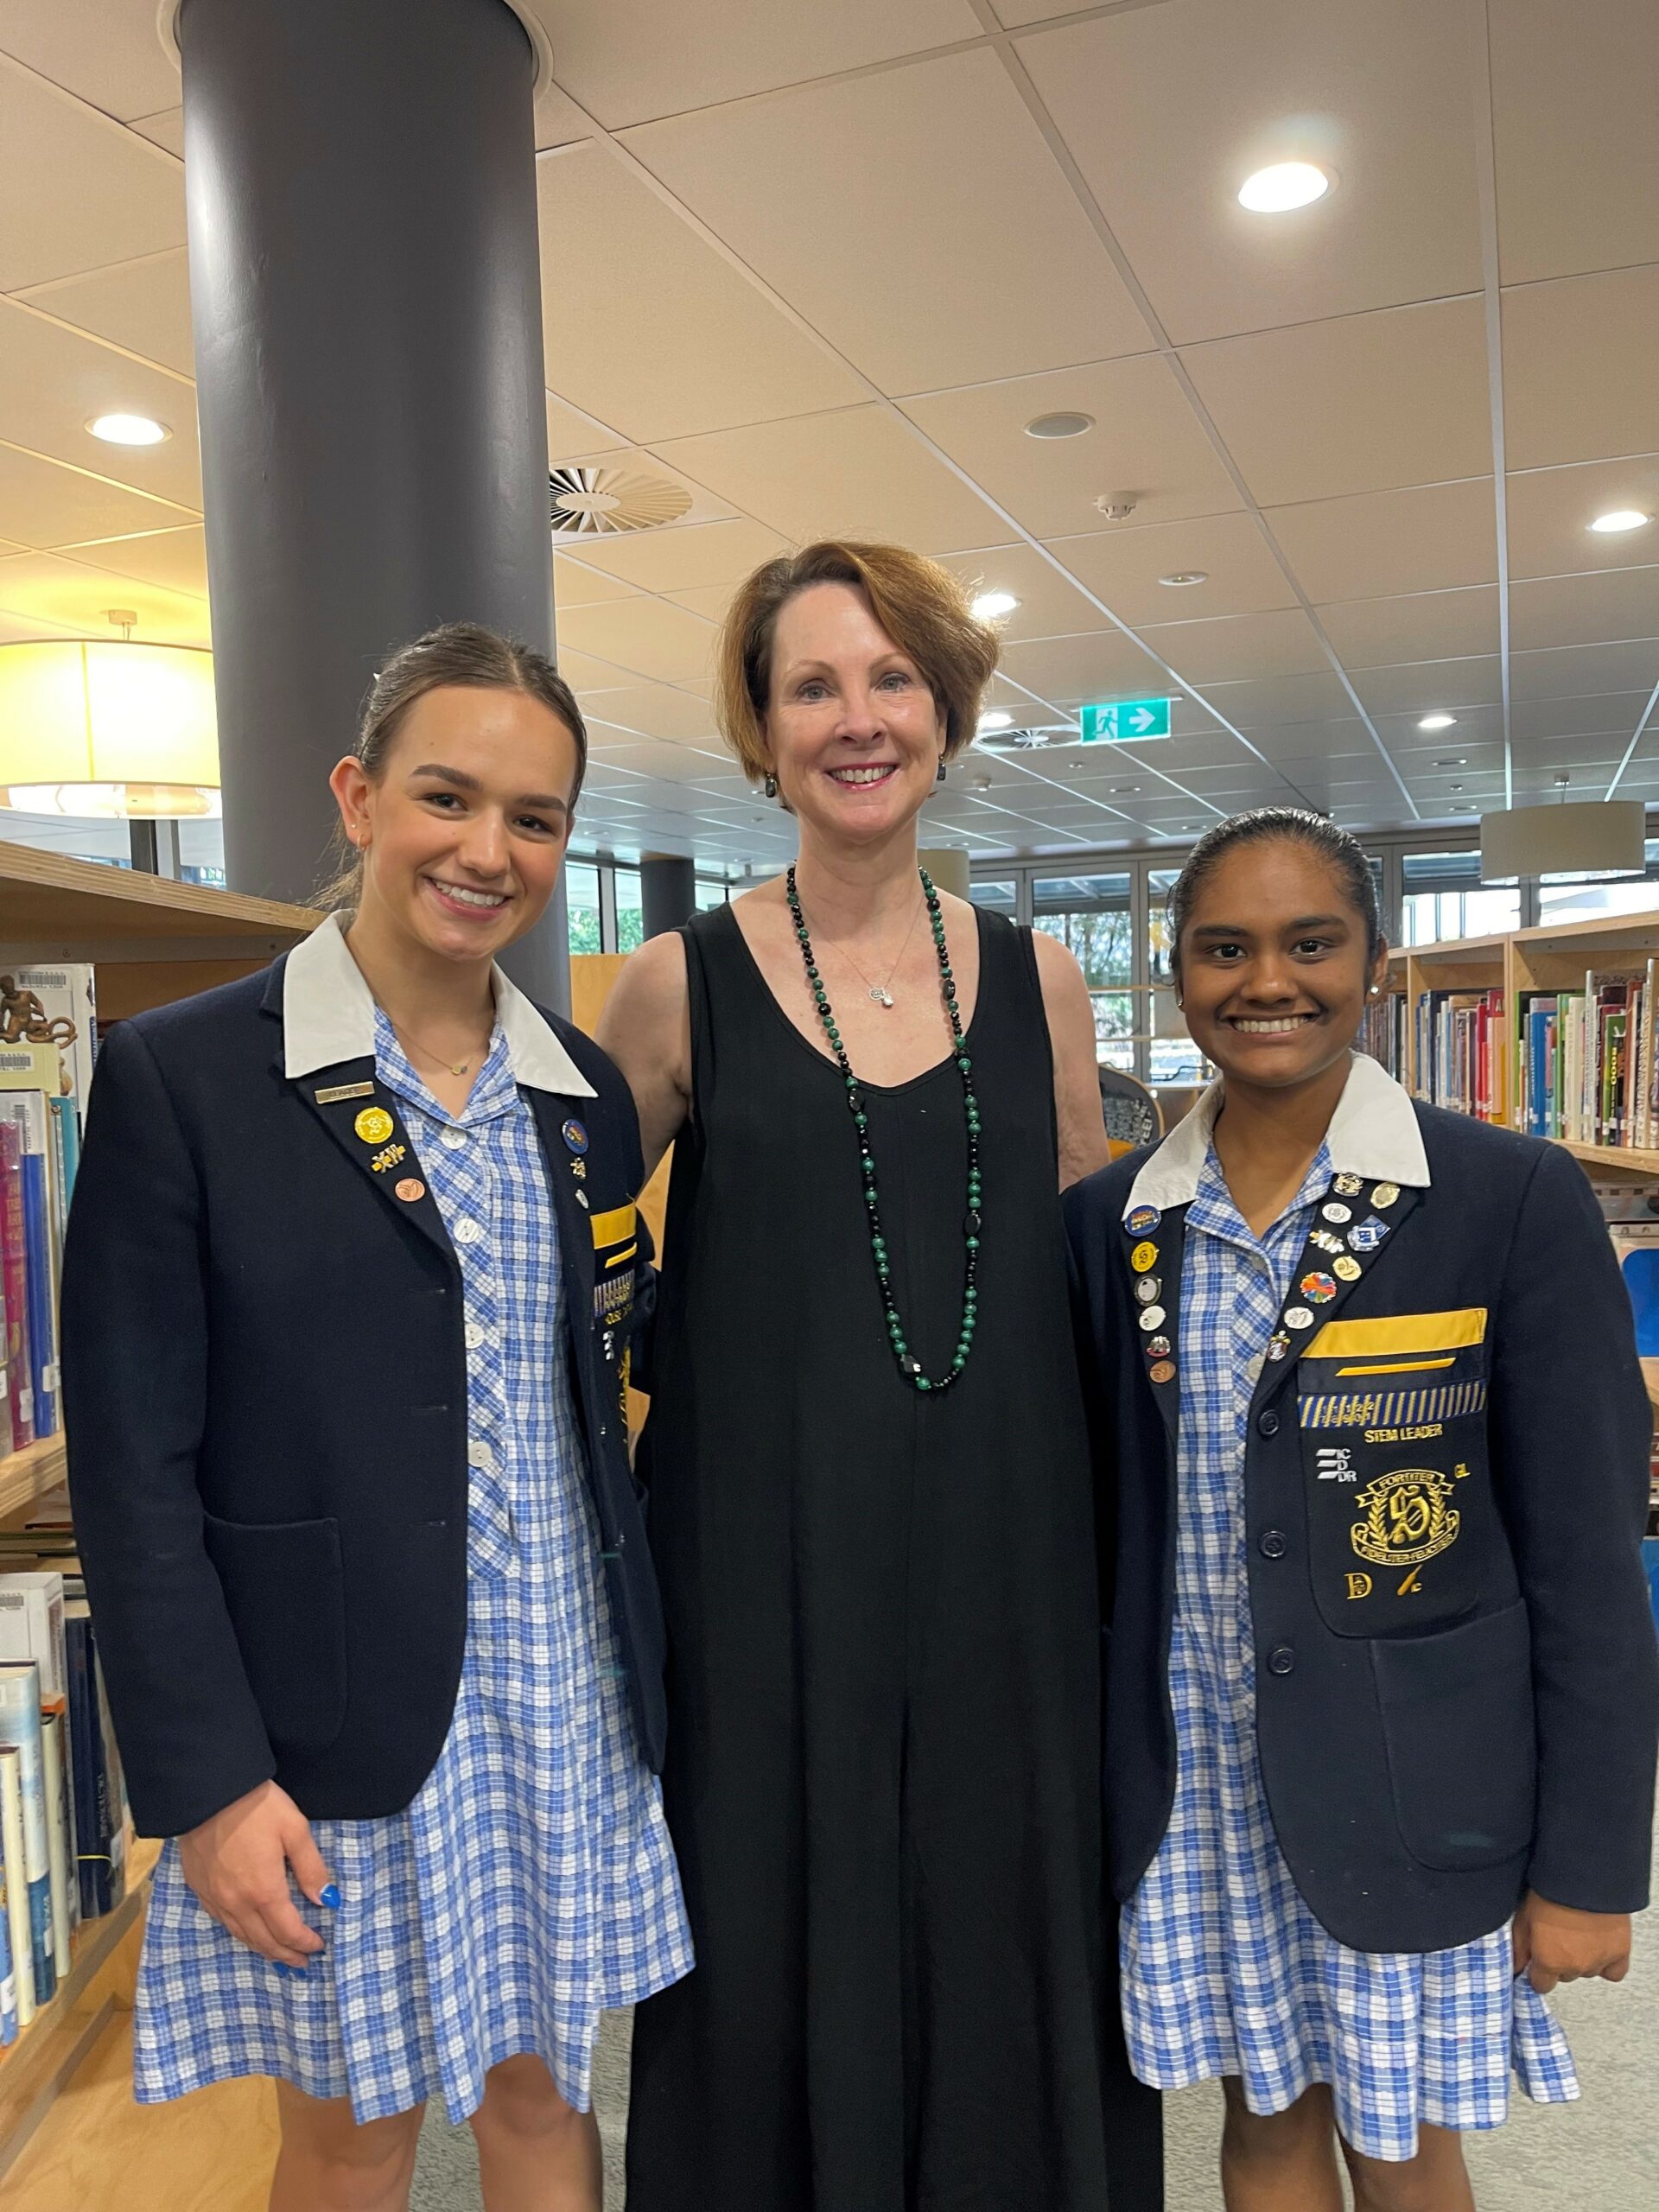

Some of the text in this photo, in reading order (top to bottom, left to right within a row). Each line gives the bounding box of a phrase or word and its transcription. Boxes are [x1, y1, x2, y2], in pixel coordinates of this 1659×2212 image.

[1364, 1423, 1443, 1444] STEM LEADER
[1338, 1471, 1357, 1483] DR
